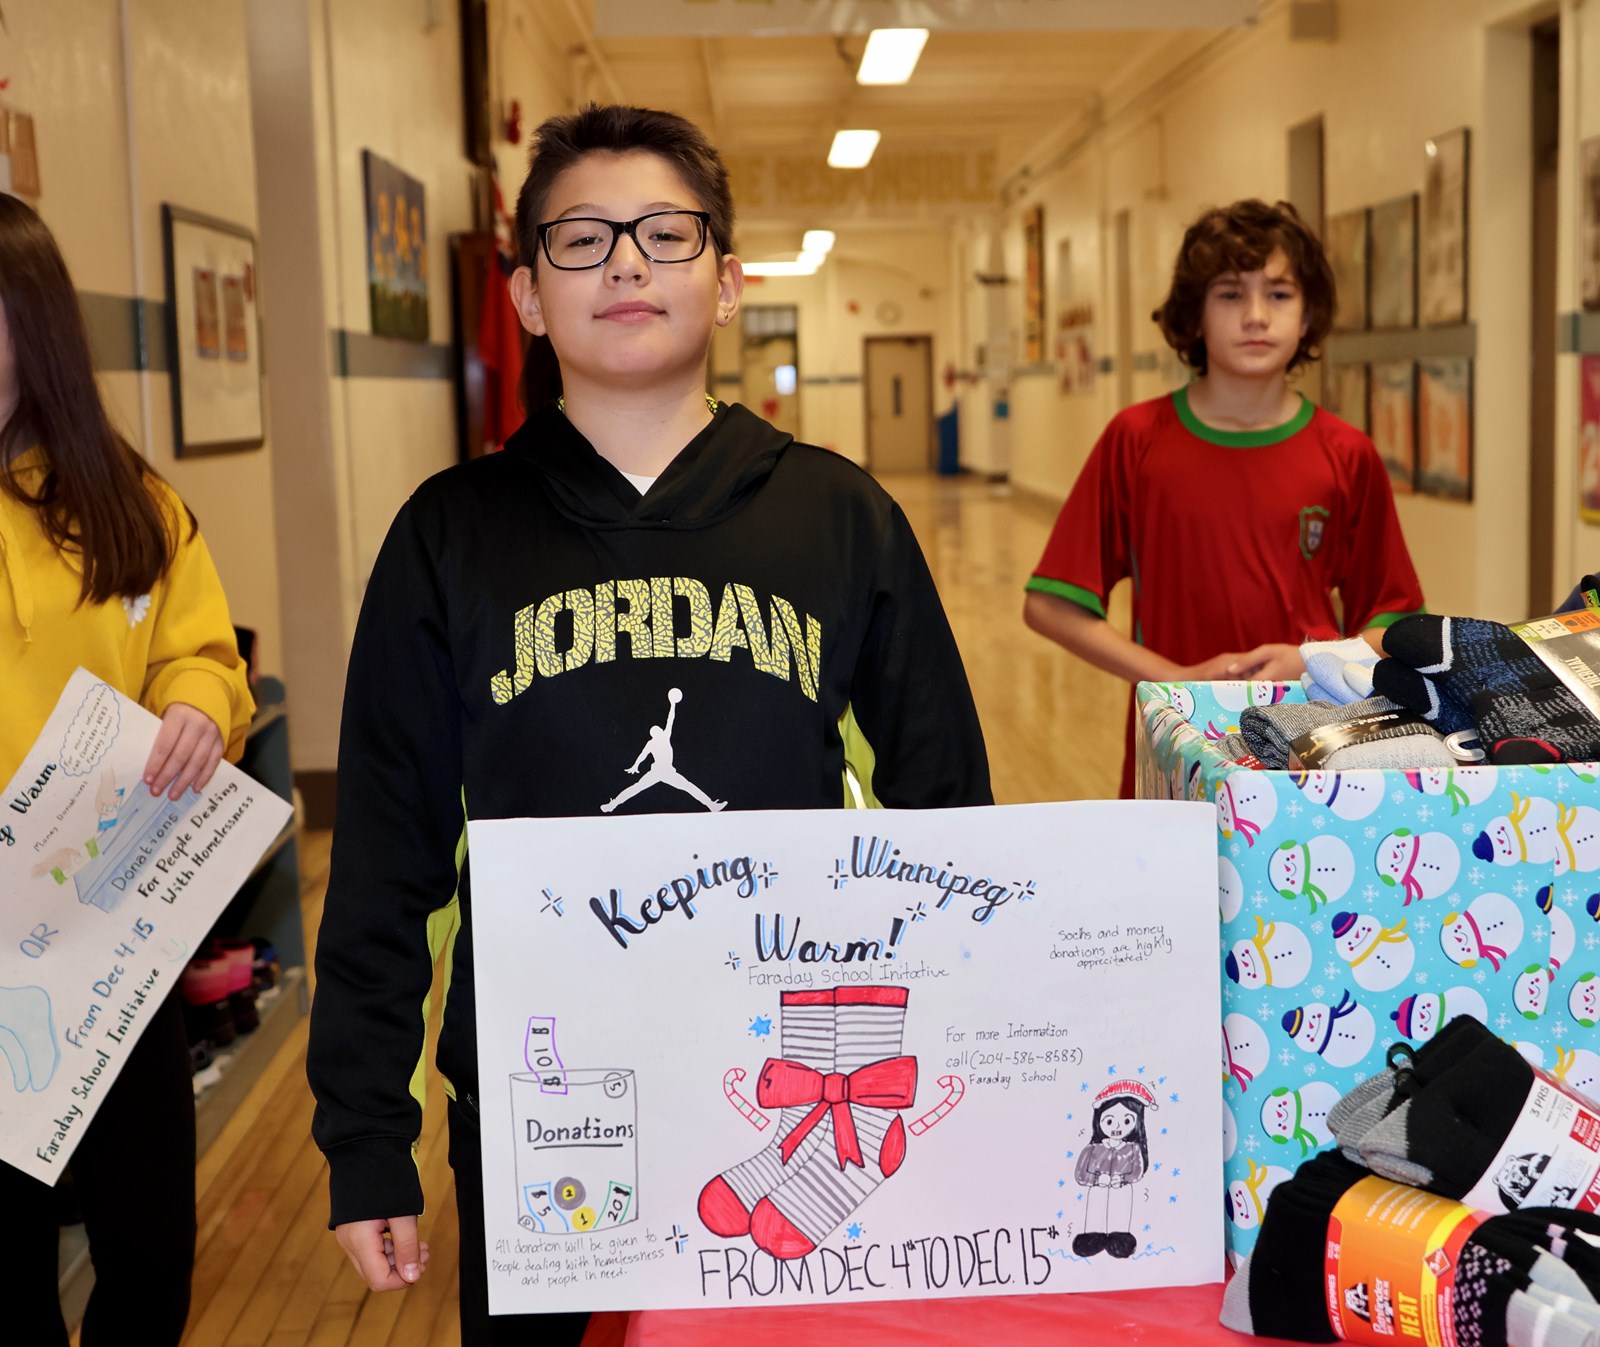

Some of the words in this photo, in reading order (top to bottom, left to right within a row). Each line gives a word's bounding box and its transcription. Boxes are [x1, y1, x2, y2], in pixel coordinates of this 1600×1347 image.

[490, 577, 822, 706] JORDAN
[56, 780, 88, 821] Donations
[111, 812, 179, 891] Donations
[137, 876, 160, 898] For
[155, 832, 192, 874] People
[189, 782, 239, 829] Dealing
[160, 869, 195, 905] With
[191, 795, 254, 867] Homelessness
[589, 853, 758, 949] Keeping
[851, 836, 1013, 924] Winnipeg
[19, 922, 58, 959] OR
[755, 913, 908, 963] Warm!
[1098, 925, 1119, 939] and
[1126, 925, 1164, 937] money
[1050, 944, 1106, 960] donations
[1113, 945, 1131, 954] are
[748, 964, 814, 987] Faraday
[66, 1003, 102, 1048] From
[92, 964, 124, 998] Dec
[945, 1025, 966, 1043] For
[975, 1031, 1000, 1041] more
[1006, 1022, 1068, 1039] Information
[36, 1103, 84, 1163] Faraday
[71, 1048, 110, 1100] School
[105, 967, 160, 1045] Initiative
[969, 1071, 1012, 1090] Faraday
[1021, 1068, 1058, 1083] School
[526, 1117, 635, 1143] Donations
[607, 1198, 624, 1222] 20
[495, 1238, 509, 1254] All
[515, 1237, 561, 1254] donation
[590, 1237, 603, 1251] be
[609, 1236, 638, 1254] given
[645, 1228, 657, 1243] to
[524, 1254, 561, 1272] dealing
[593, 1249, 666, 1269] homelessness
[521, 1274, 540, 1286] and
[548, 1272, 579, 1288] people
[698, 1247, 814, 1300] FROM
[914, 1236, 950, 1289] TO
[1397, 1290, 1422, 1338] HEAT
